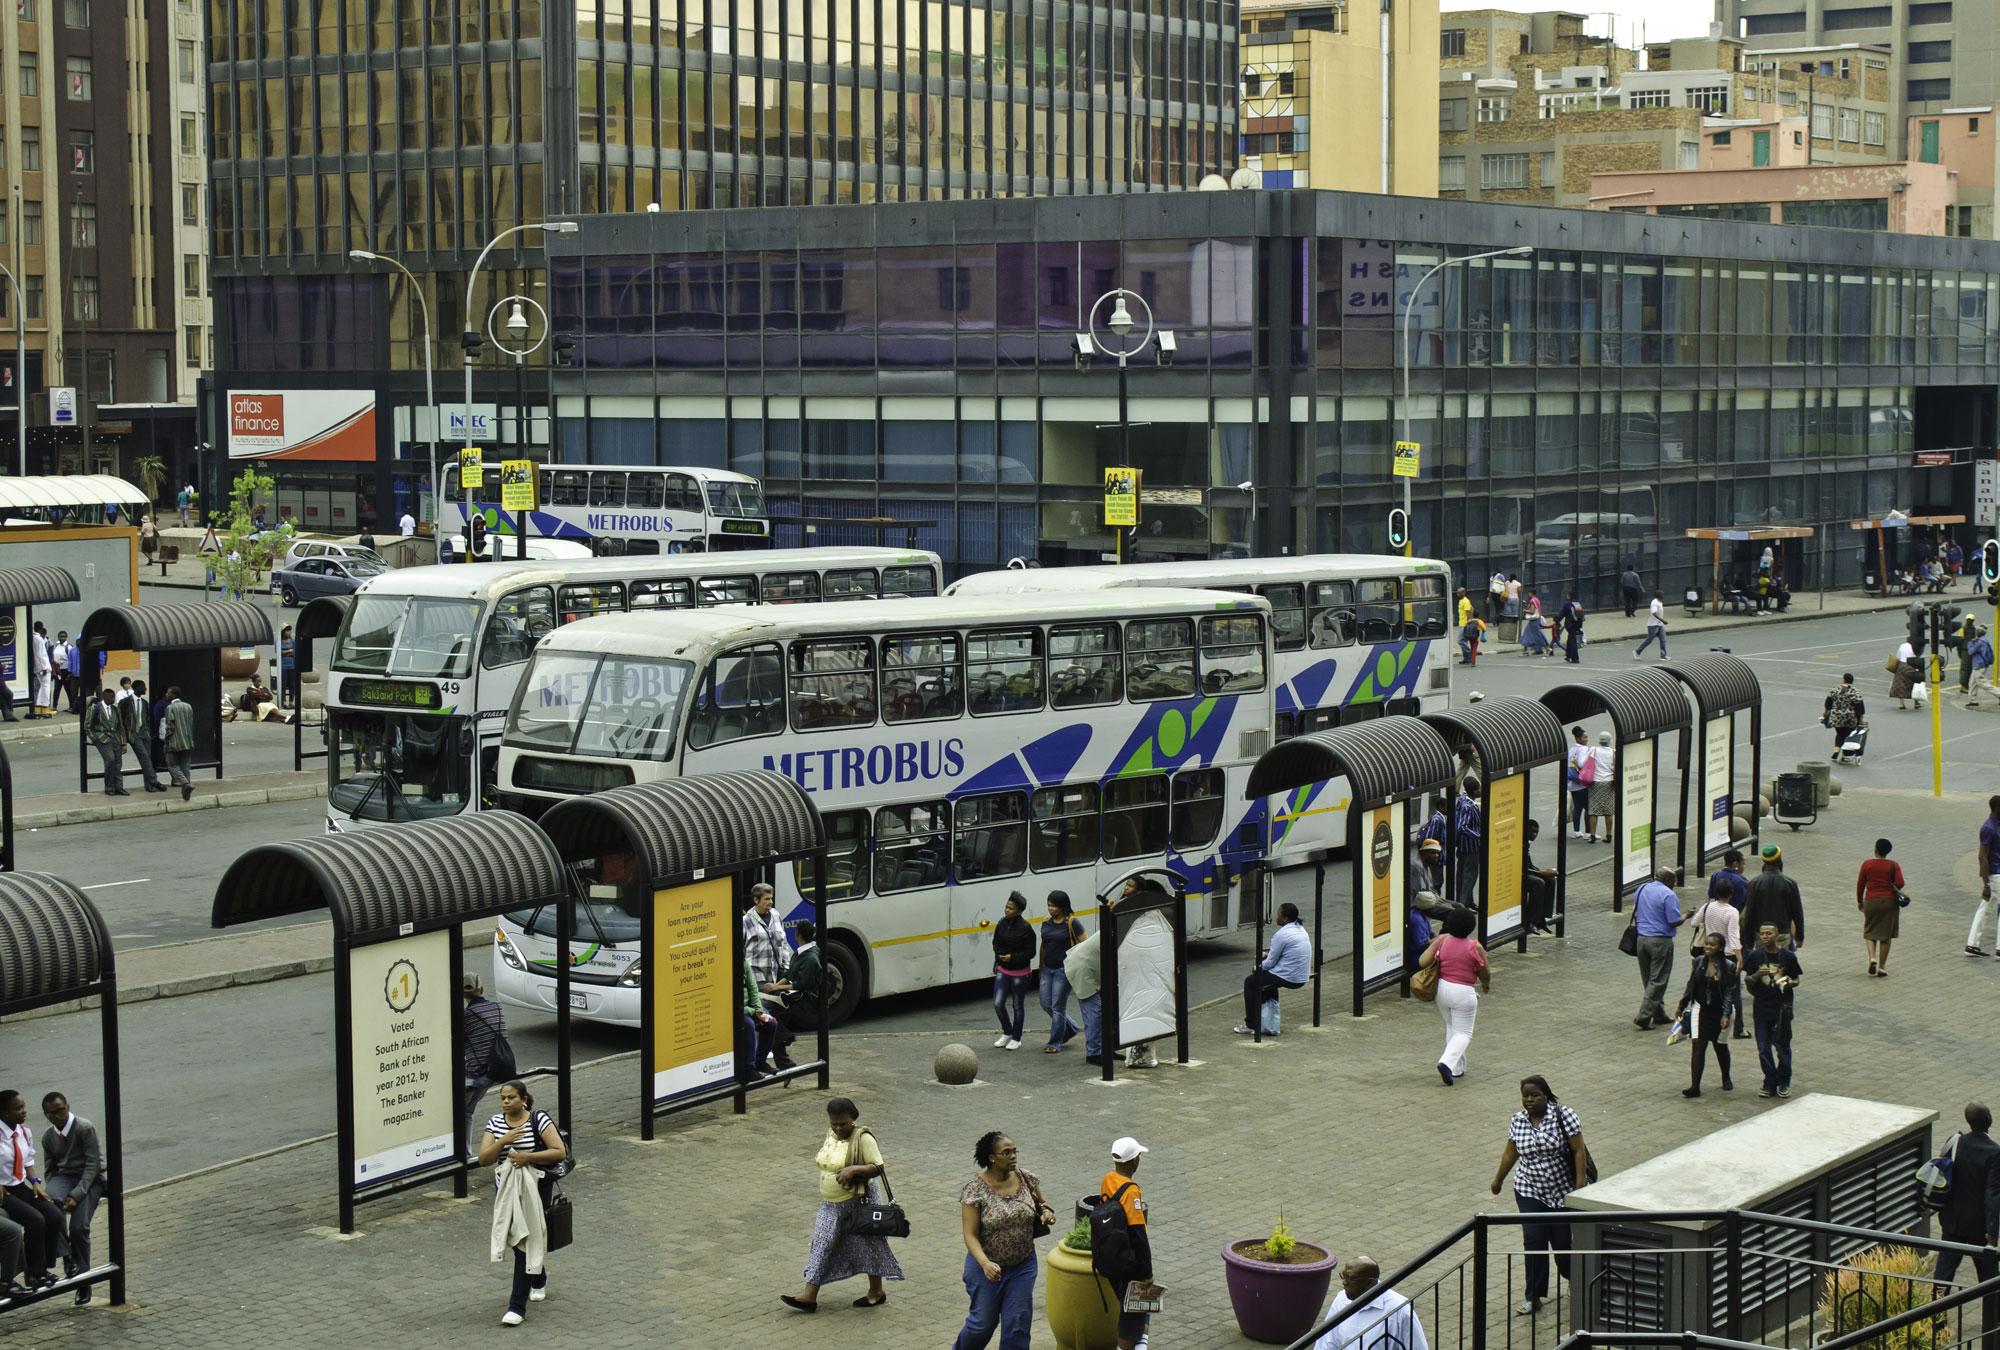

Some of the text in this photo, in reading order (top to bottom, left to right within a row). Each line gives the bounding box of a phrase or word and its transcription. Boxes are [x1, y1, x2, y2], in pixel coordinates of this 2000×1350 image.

[234, 399, 262, 414] atlas
[234, 416, 280, 431] finance
[450, 411, 487, 428] INEC
[587, 514, 673, 532] METROBUS
[441, 682, 460, 694] 49
[540, 665, 687, 707] METROBU
[763, 738, 965, 793] METROBUS
[680, 901, 704, 912] Are your
[667, 910, 716, 927] loan repayments
[677, 930, 685, 938] up
[611, 954, 631, 962] 5053
[670, 943, 717, 961] You could qualify
[672, 964, 680, 973] for
[391, 973, 410, 1000] #1
[679, 975, 693, 986] your
[391, 1019, 415, 1033] Voted
[375, 1035, 430, 1055] South African
[380, 1053, 426, 1073] Bank of the
[376, 1070, 430, 1095] year 2012, by
[380, 1089, 426, 1109] The Banker
[383, 1109, 425, 1127] magazine.
